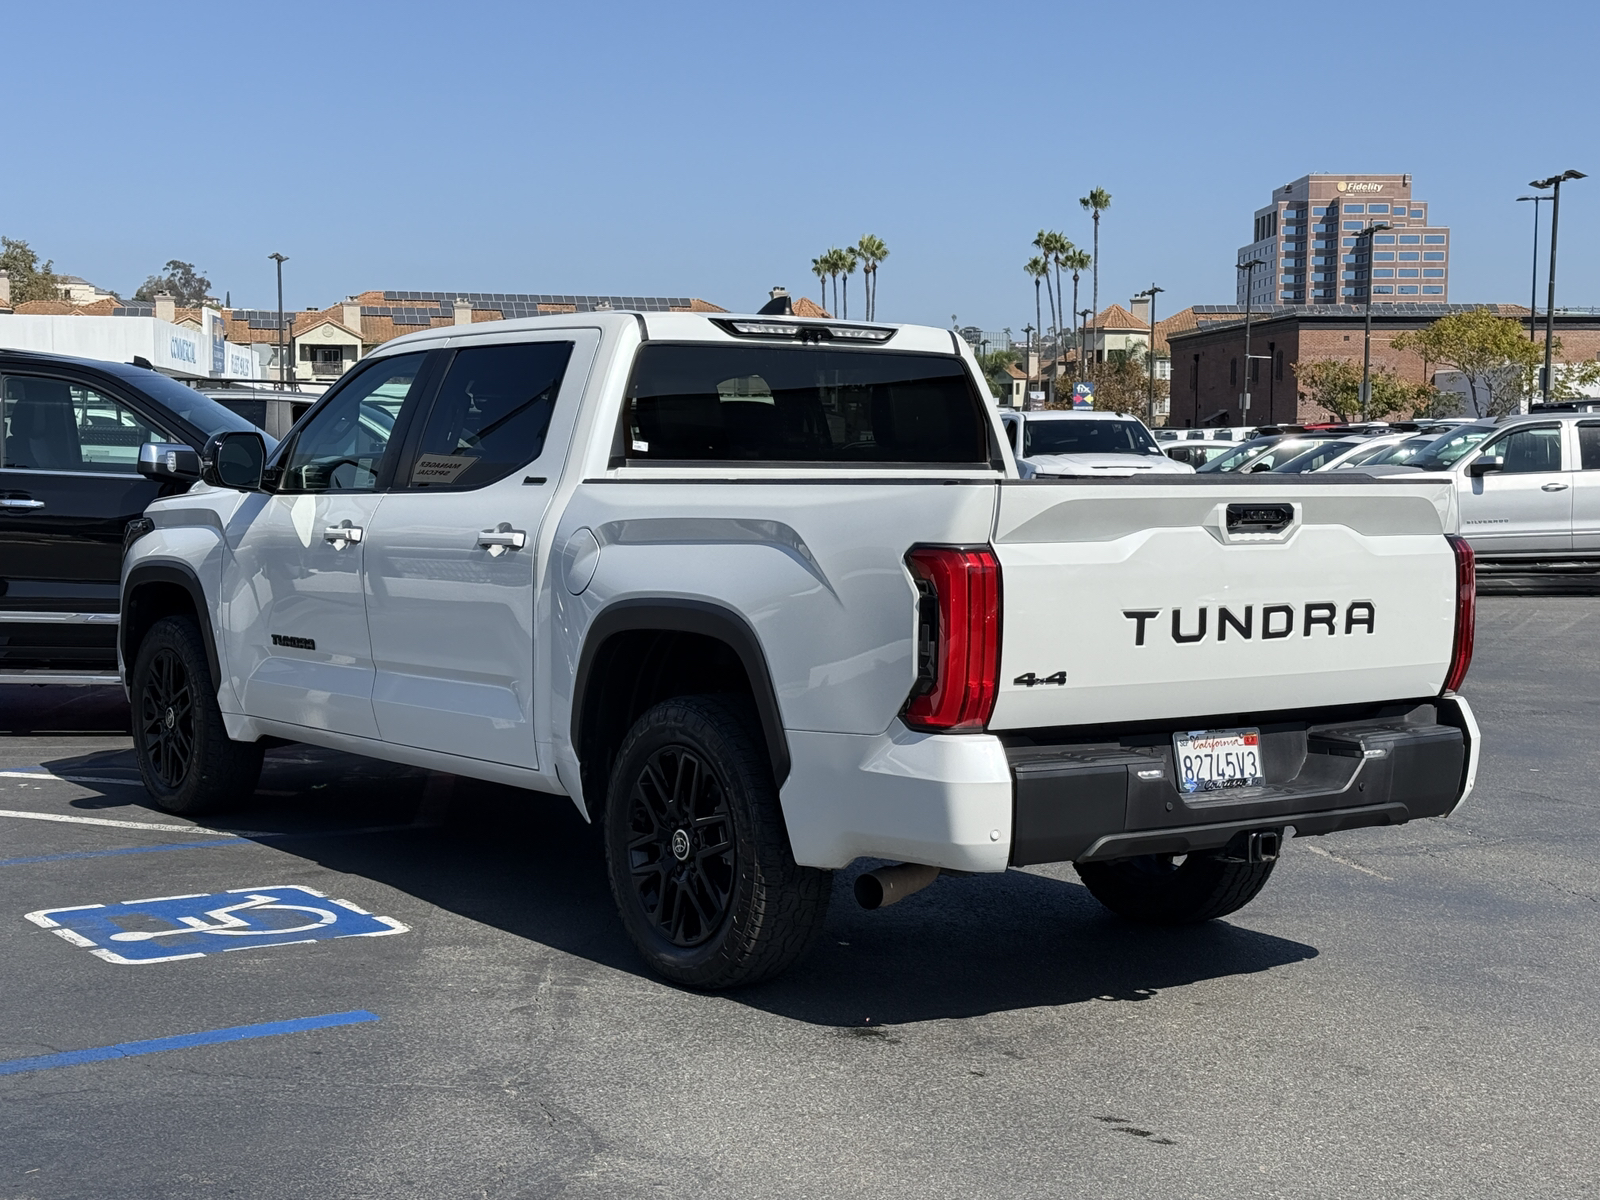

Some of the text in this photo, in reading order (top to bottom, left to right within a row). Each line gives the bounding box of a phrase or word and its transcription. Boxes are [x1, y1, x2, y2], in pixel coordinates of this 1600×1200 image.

[1347, 183, 1384, 192] Fidelity
[1077, 384, 1092, 393] fix
[1122, 600, 1376, 647] TUNDRA
[271, 634, 316, 650] TUNDRA
[1192, 736, 1244, 752] California
[1183, 751, 1258, 782] 82745V3
